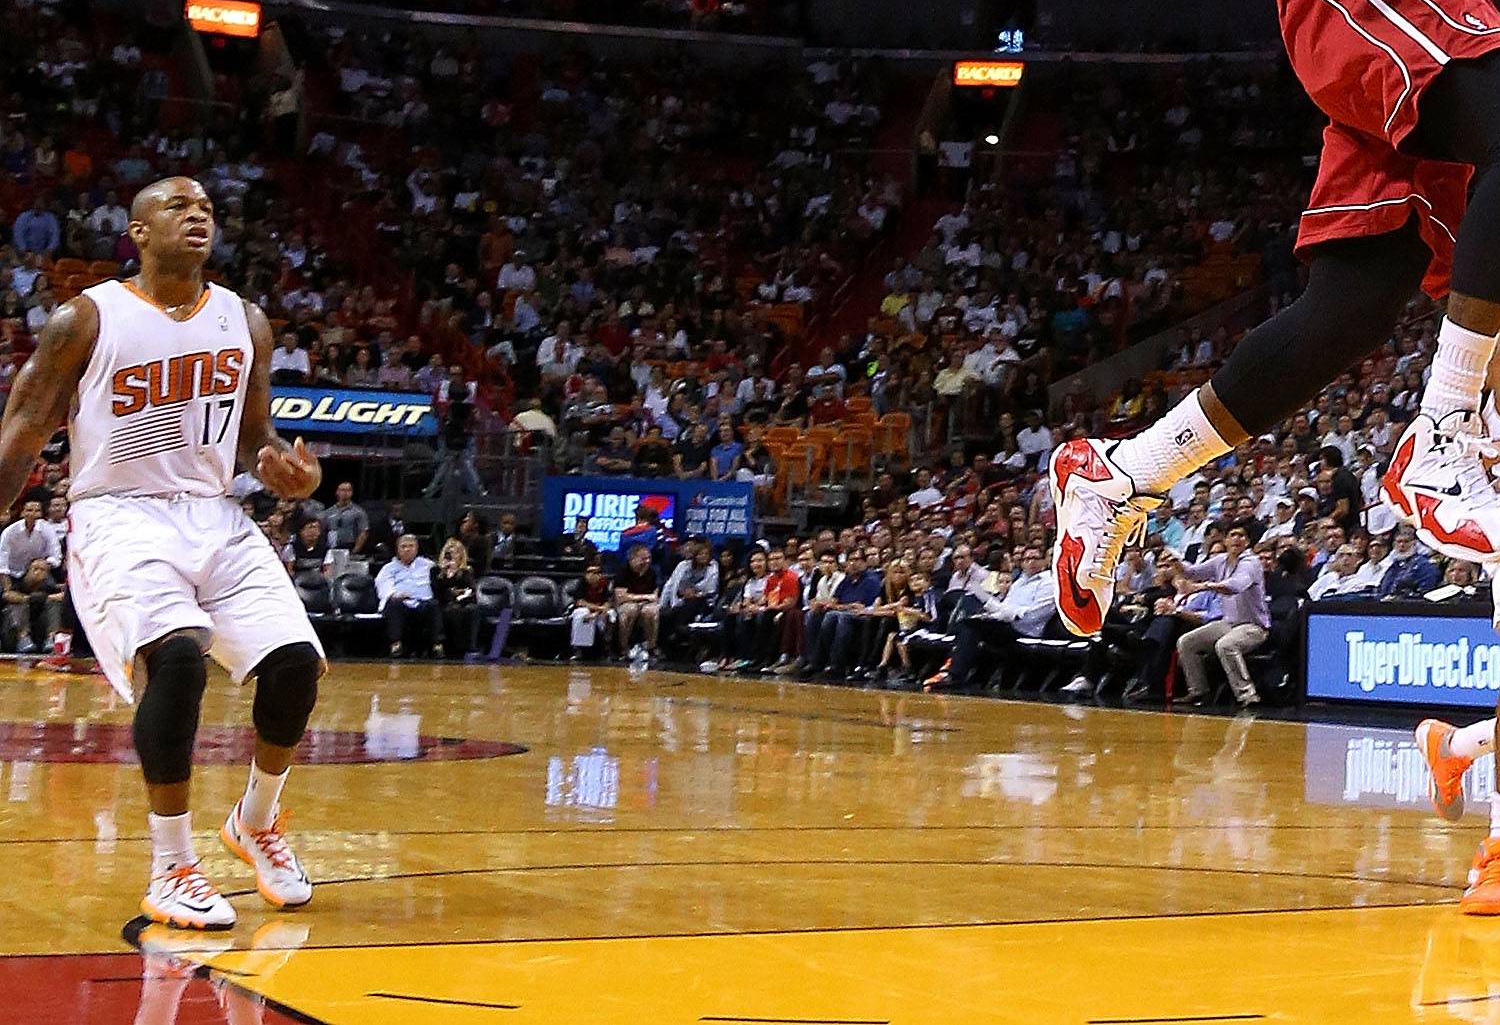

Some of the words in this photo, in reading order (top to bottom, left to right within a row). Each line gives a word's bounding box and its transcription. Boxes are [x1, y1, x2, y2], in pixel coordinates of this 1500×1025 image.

[201, 398, 235, 446] 17
[310, 397, 431, 425] LIGHT
[564, 492, 594, 518] DJ
[595, 493, 640, 518] IRIE
